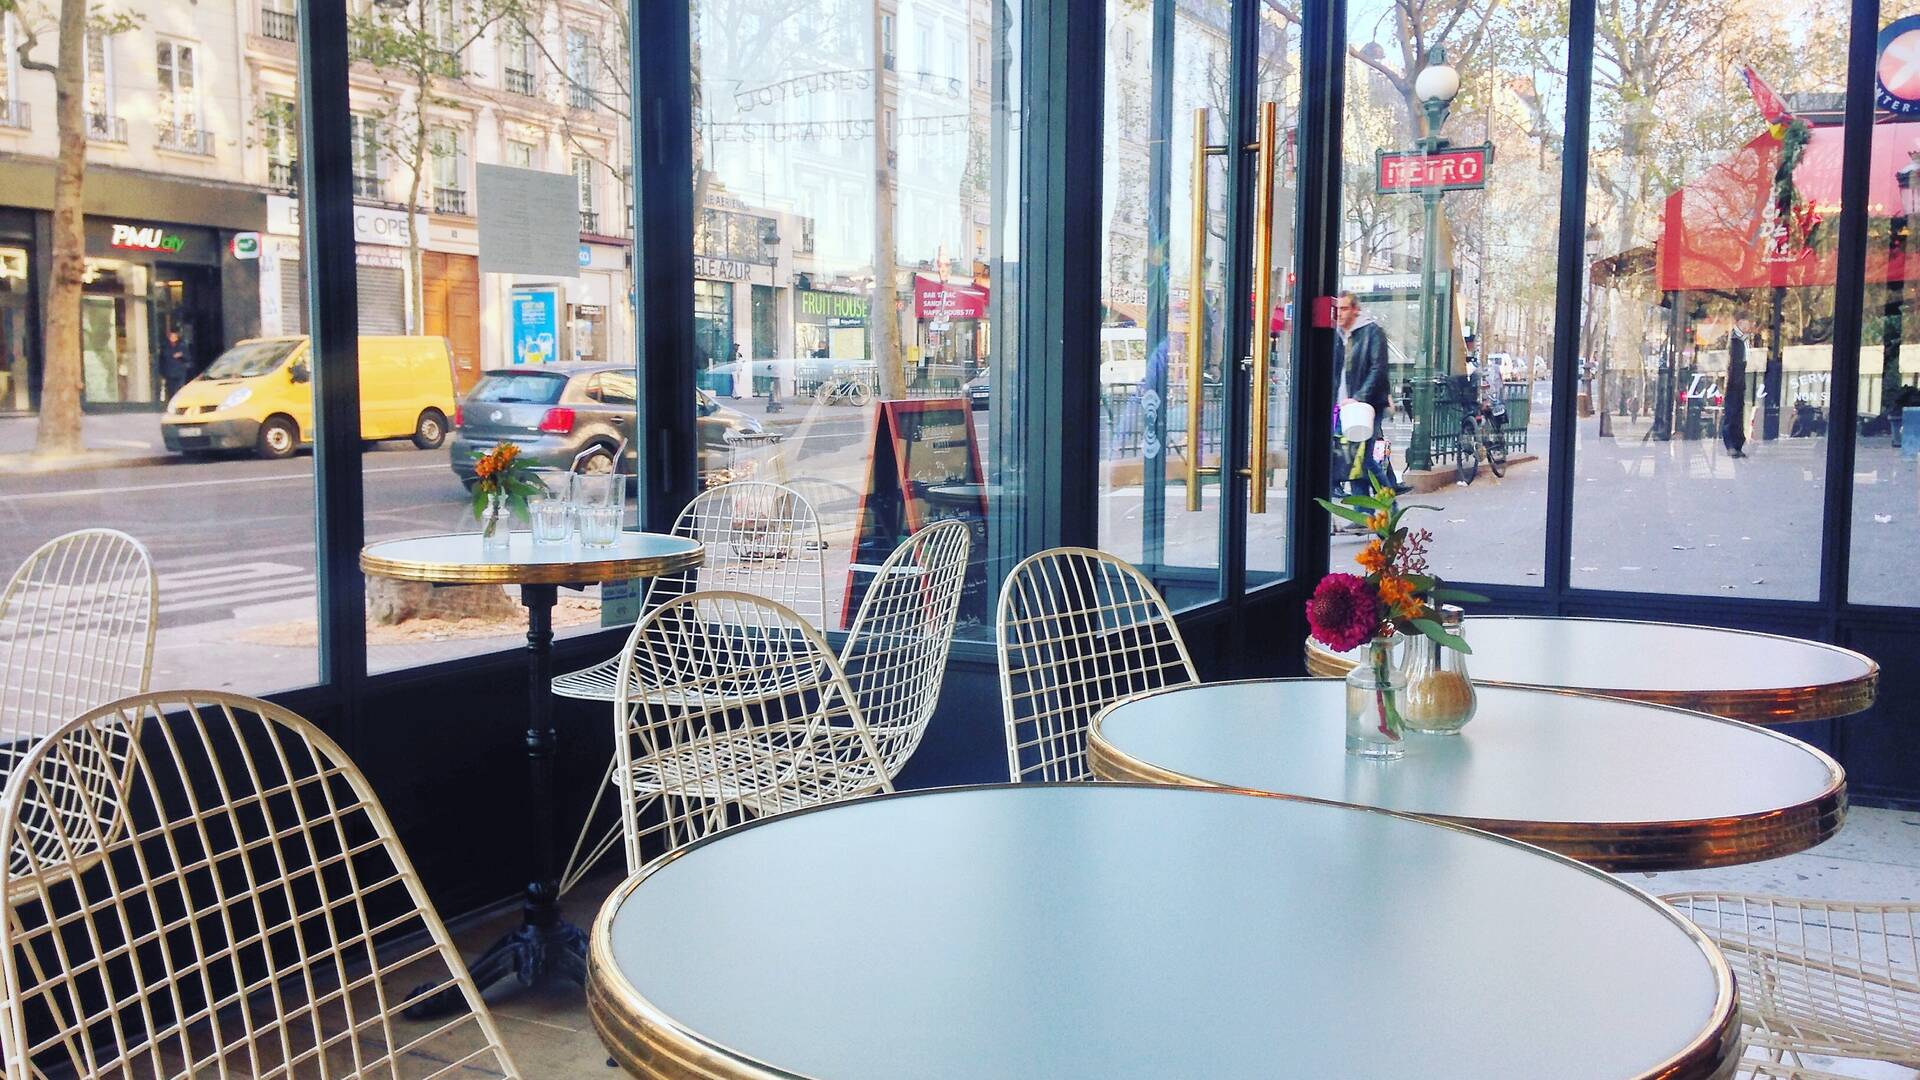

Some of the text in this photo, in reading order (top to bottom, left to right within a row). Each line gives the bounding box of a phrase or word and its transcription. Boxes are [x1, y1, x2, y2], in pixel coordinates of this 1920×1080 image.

[1389, 157, 1477, 183] METRO
[111, 224, 163, 249] PMU
[694, 257, 752, 281] GLE AZUR
[802, 292, 868, 317] FRUIT HOUSE
[1793, 390, 1818, 402] NON
